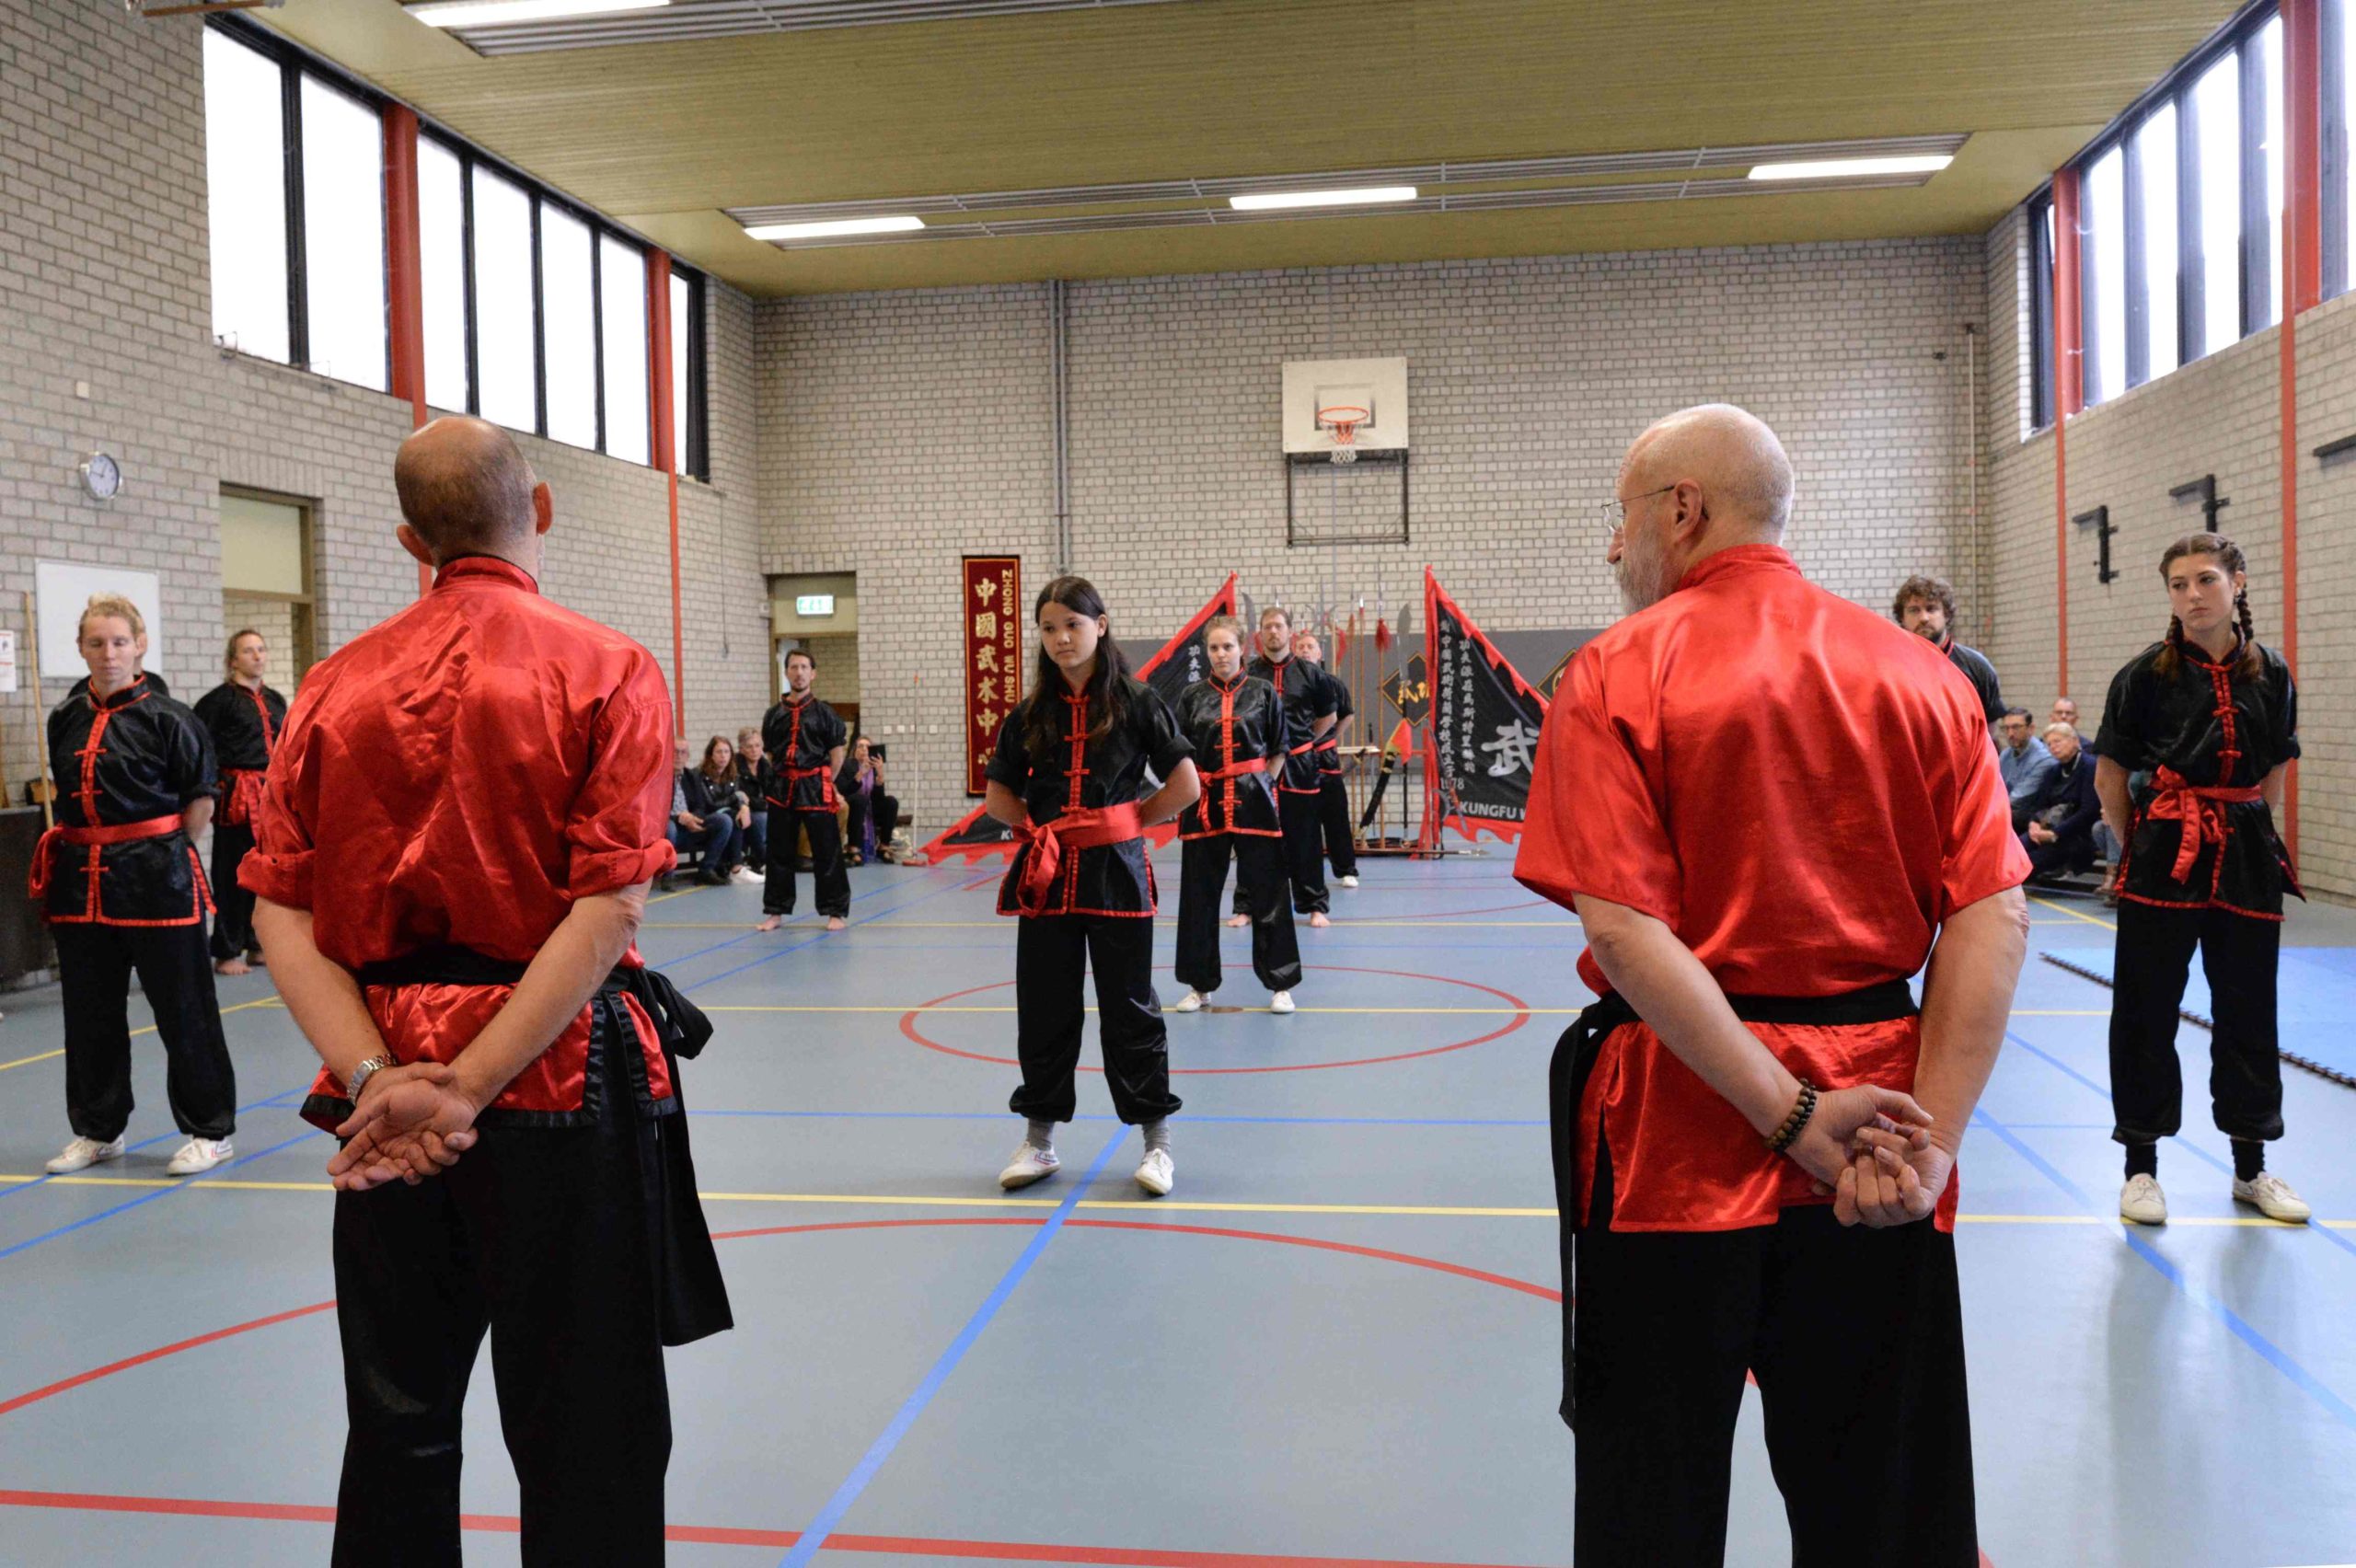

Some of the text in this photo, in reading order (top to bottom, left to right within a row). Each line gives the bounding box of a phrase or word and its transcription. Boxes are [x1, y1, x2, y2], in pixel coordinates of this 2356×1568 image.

[1001, 569, 1014, 616] ZHONG
[1003, 621, 1015, 649] GUO
[1003, 655, 1015, 674] WU
[1004, 675, 1016, 703] SHU
[1481, 718, 1541, 778] 武
[1461, 800, 1517, 820] KUNGFU
